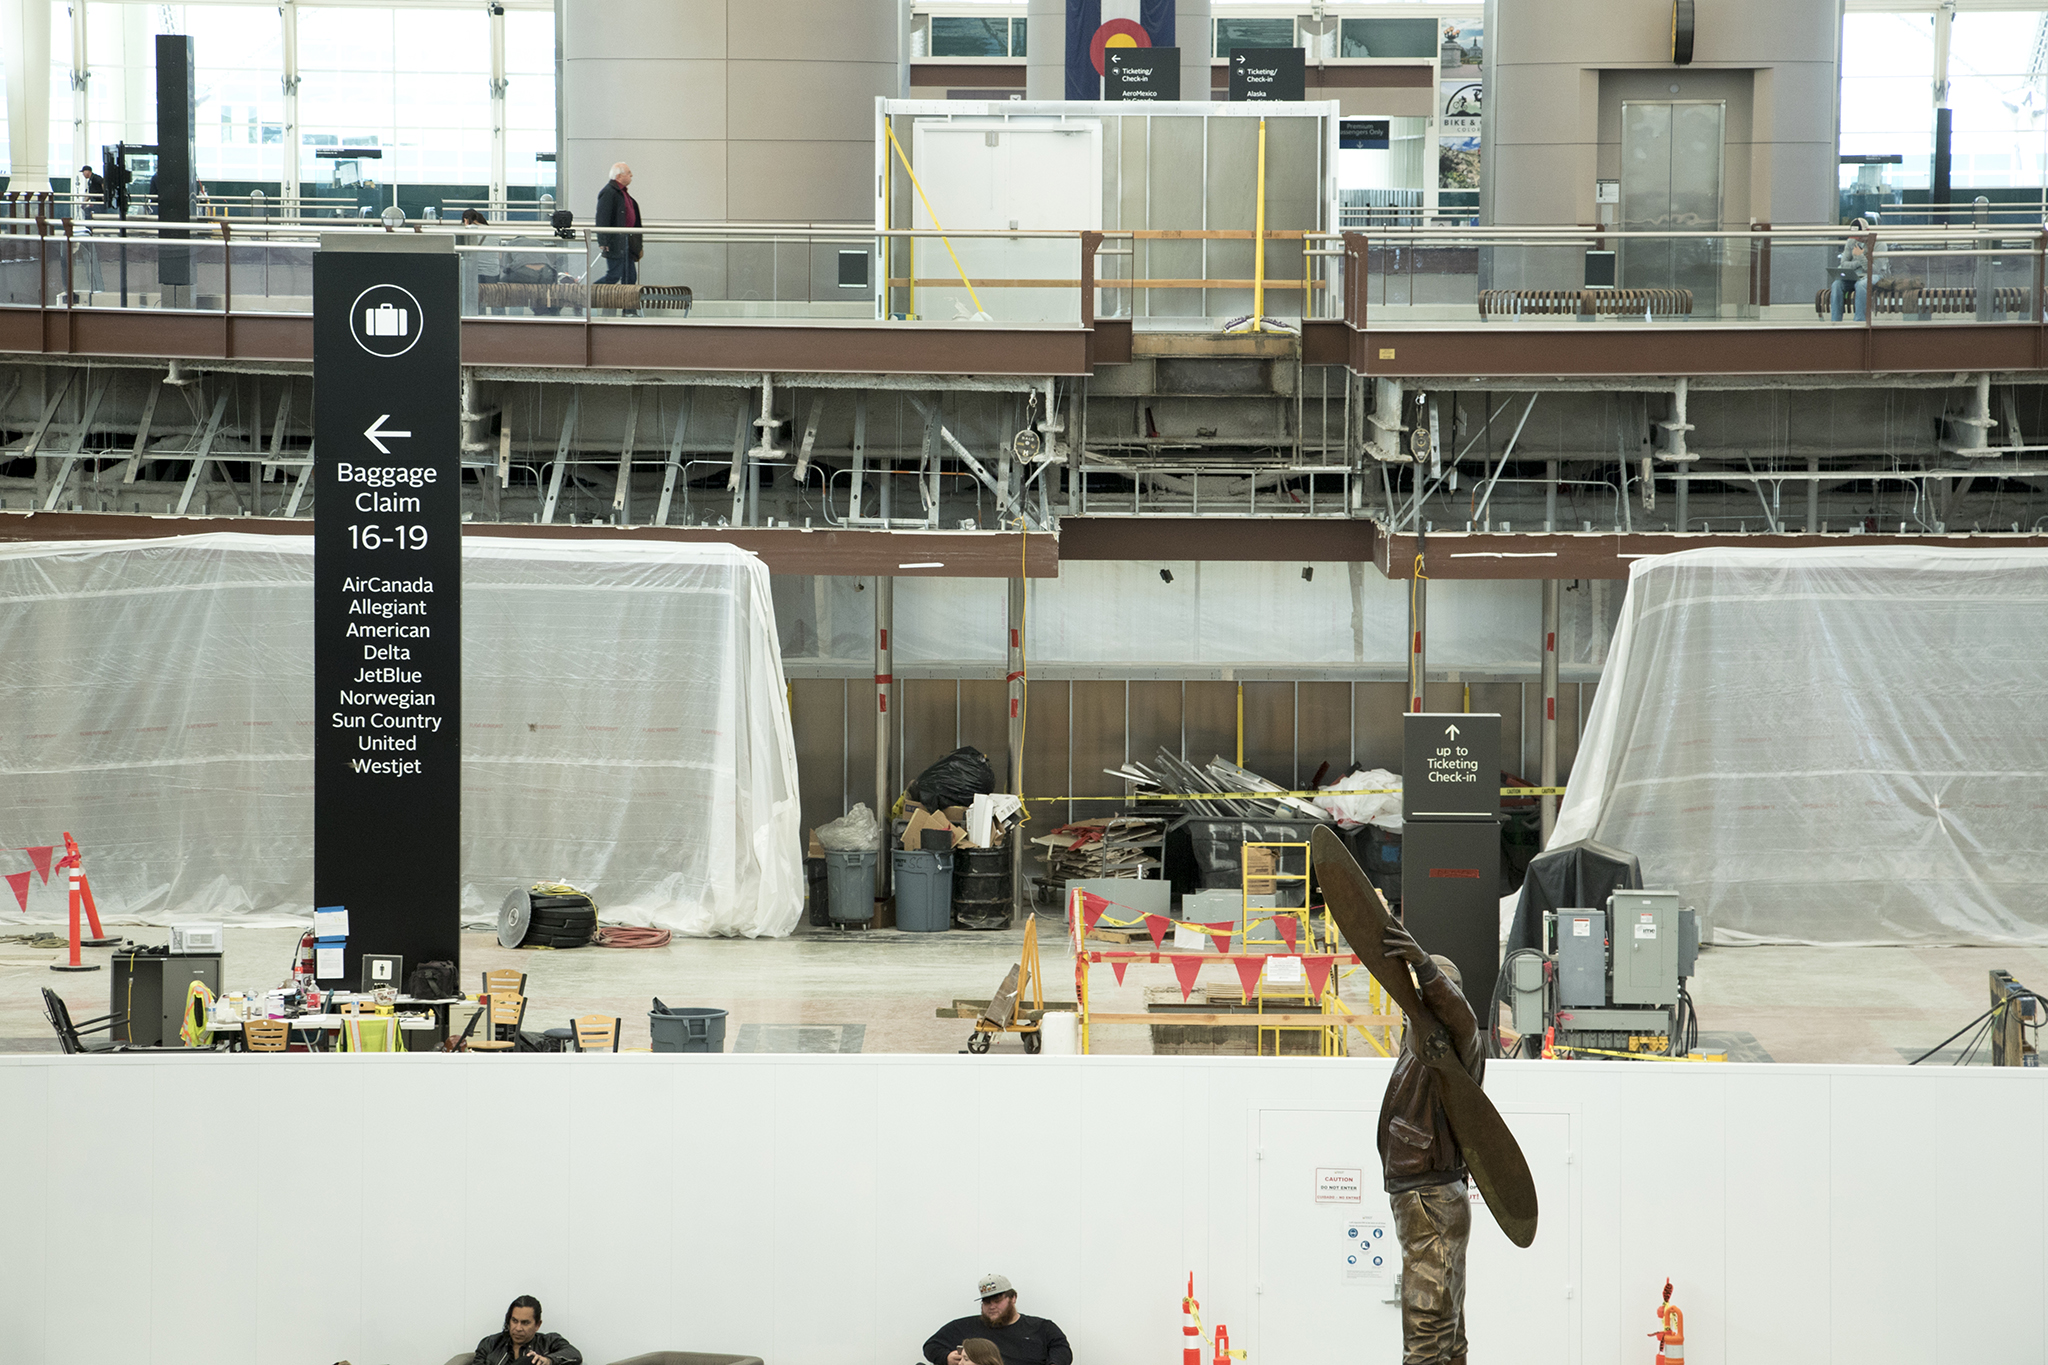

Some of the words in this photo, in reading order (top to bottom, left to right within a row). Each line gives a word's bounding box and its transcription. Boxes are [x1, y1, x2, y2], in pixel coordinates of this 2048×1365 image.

[1122, 67, 1153, 76] Ticketing/
[1247, 68, 1278, 76] Ticketing/
[1340, 129, 1368, 137] assengers
[1369, 128, 1384, 137] Only
[1346, 122, 1374, 130] Premium
[337, 462, 438, 488] Baggage
[355, 491, 421, 513] Claim
[347, 524, 429, 551] 16-19
[342, 576, 434, 593] AirCanada
[348, 598, 428, 619] Allegiant
[345, 622, 431, 638] American
[364, 643, 411, 660] Delta
[353, 667, 422, 683] JetBlue
[340, 689, 436, 710] Norwegian
[332, 712, 366, 728] Sun
[370, 713, 442, 733] Country
[358, 734, 417, 751] United
[1436, 747, 1452, 758] up
[1455, 746, 1469, 757] to
[351, 758, 422, 778] Westjet
[1427, 758, 1479, 772] Ticketing
[1428, 771, 1477, 783] Check-in
